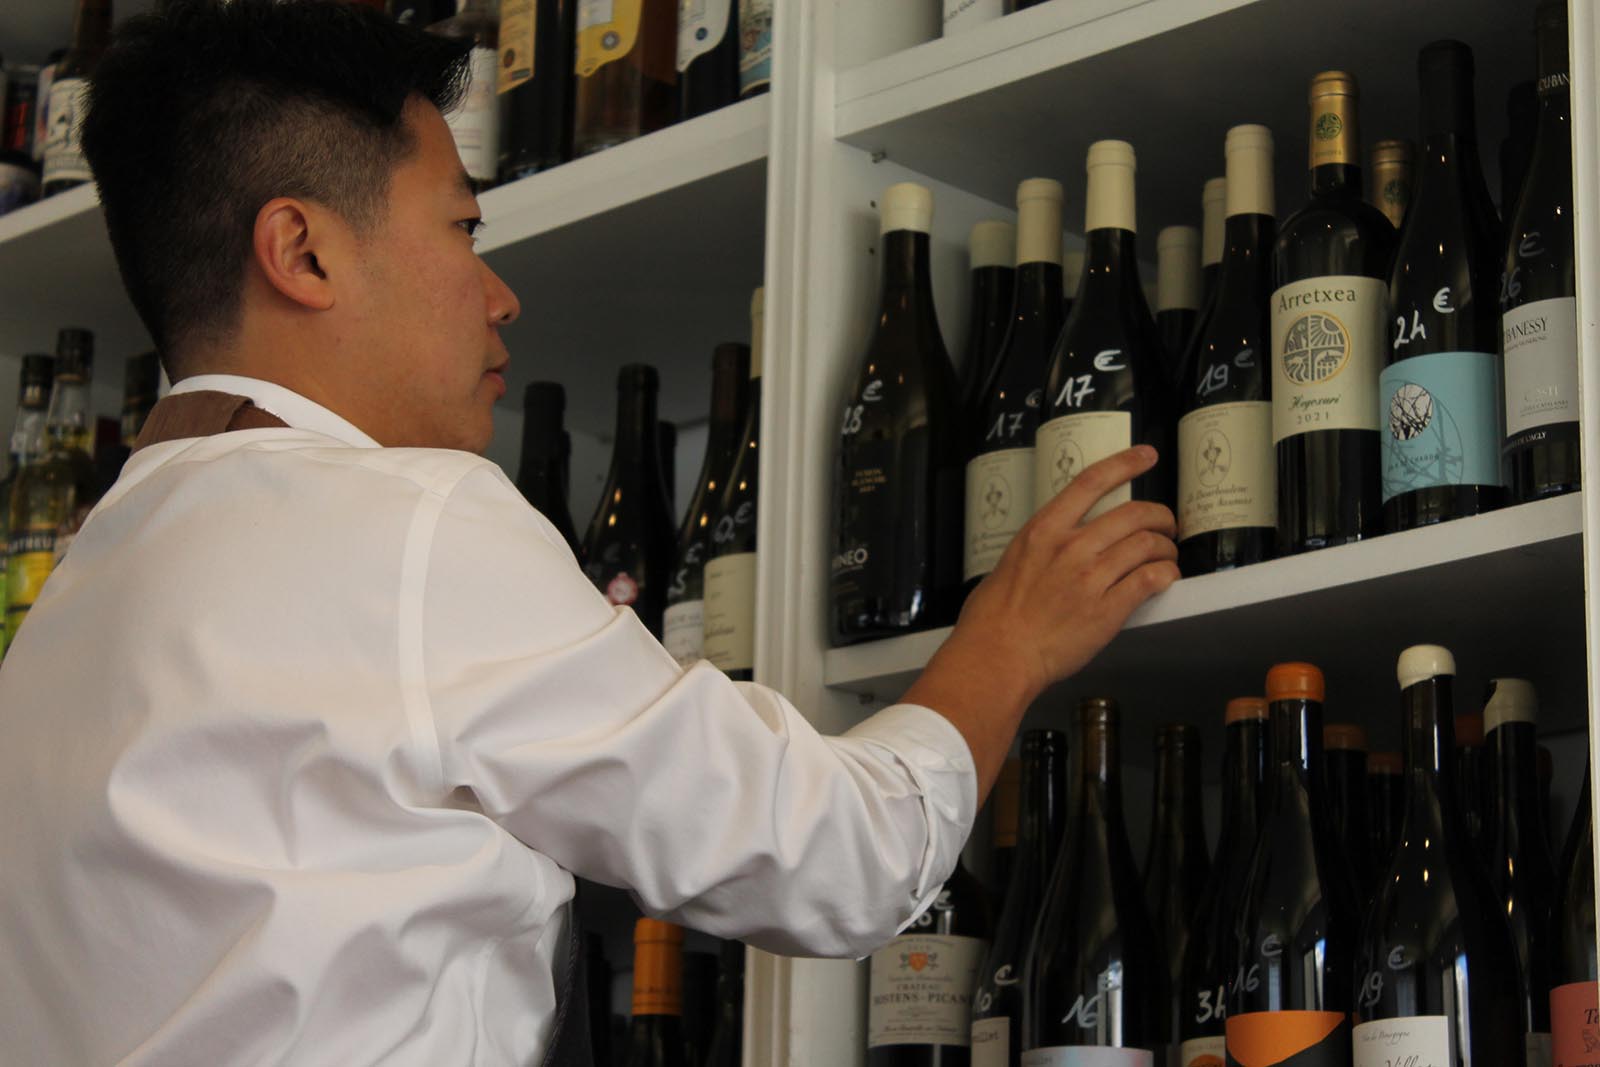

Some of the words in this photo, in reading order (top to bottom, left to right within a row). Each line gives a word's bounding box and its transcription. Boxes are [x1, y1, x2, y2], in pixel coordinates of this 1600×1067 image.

[1278, 288, 1357, 312] Arretxea
[1433, 287, 1455, 313] €
[1055, 374, 1095, 407] 17
[1196, 363, 1229, 396] 19
[986, 412, 1024, 440] 17
[1297, 412, 1330, 424] 2021
[1232, 964, 1260, 993] 16
